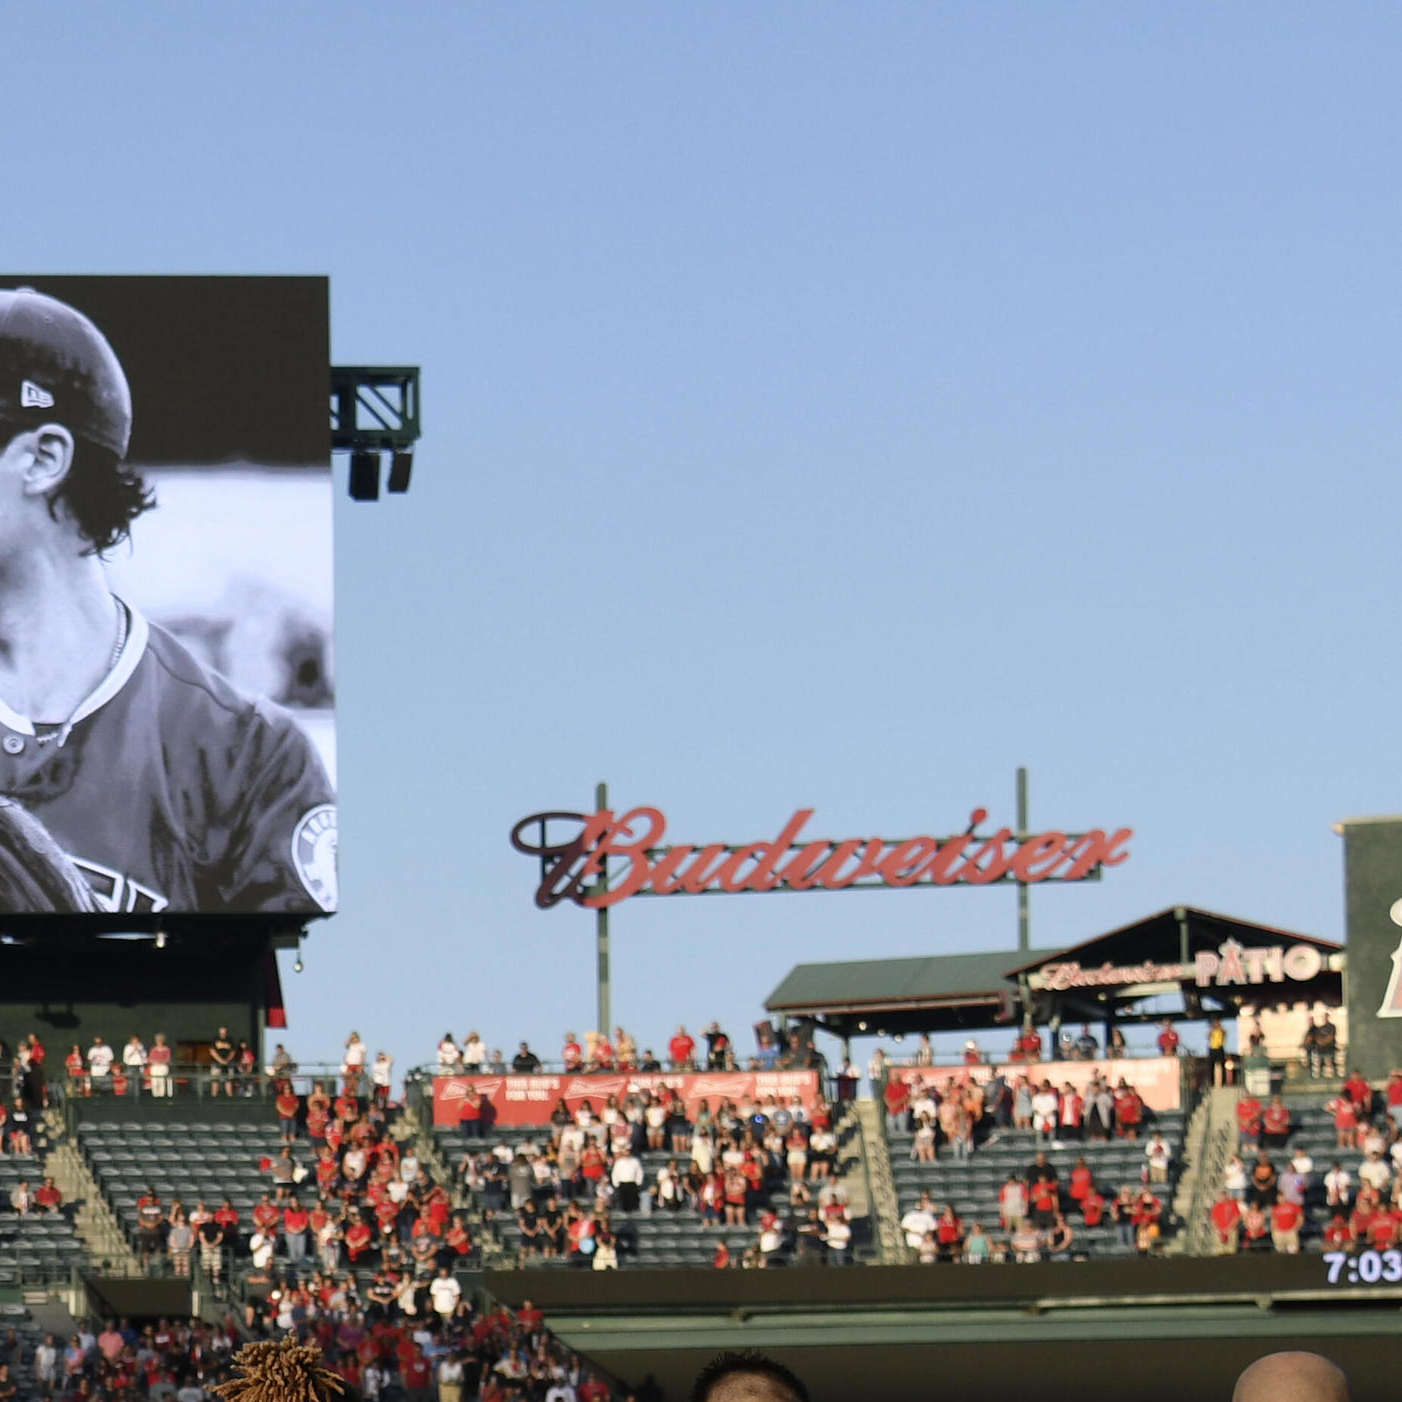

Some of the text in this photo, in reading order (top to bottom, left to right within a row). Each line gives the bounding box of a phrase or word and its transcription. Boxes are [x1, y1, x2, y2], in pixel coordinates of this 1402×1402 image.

[510, 806, 1133, 909] Budweiser
[1196, 938, 1321, 987] PATIO
[1323, 1249, 1402, 1283] 7:03
